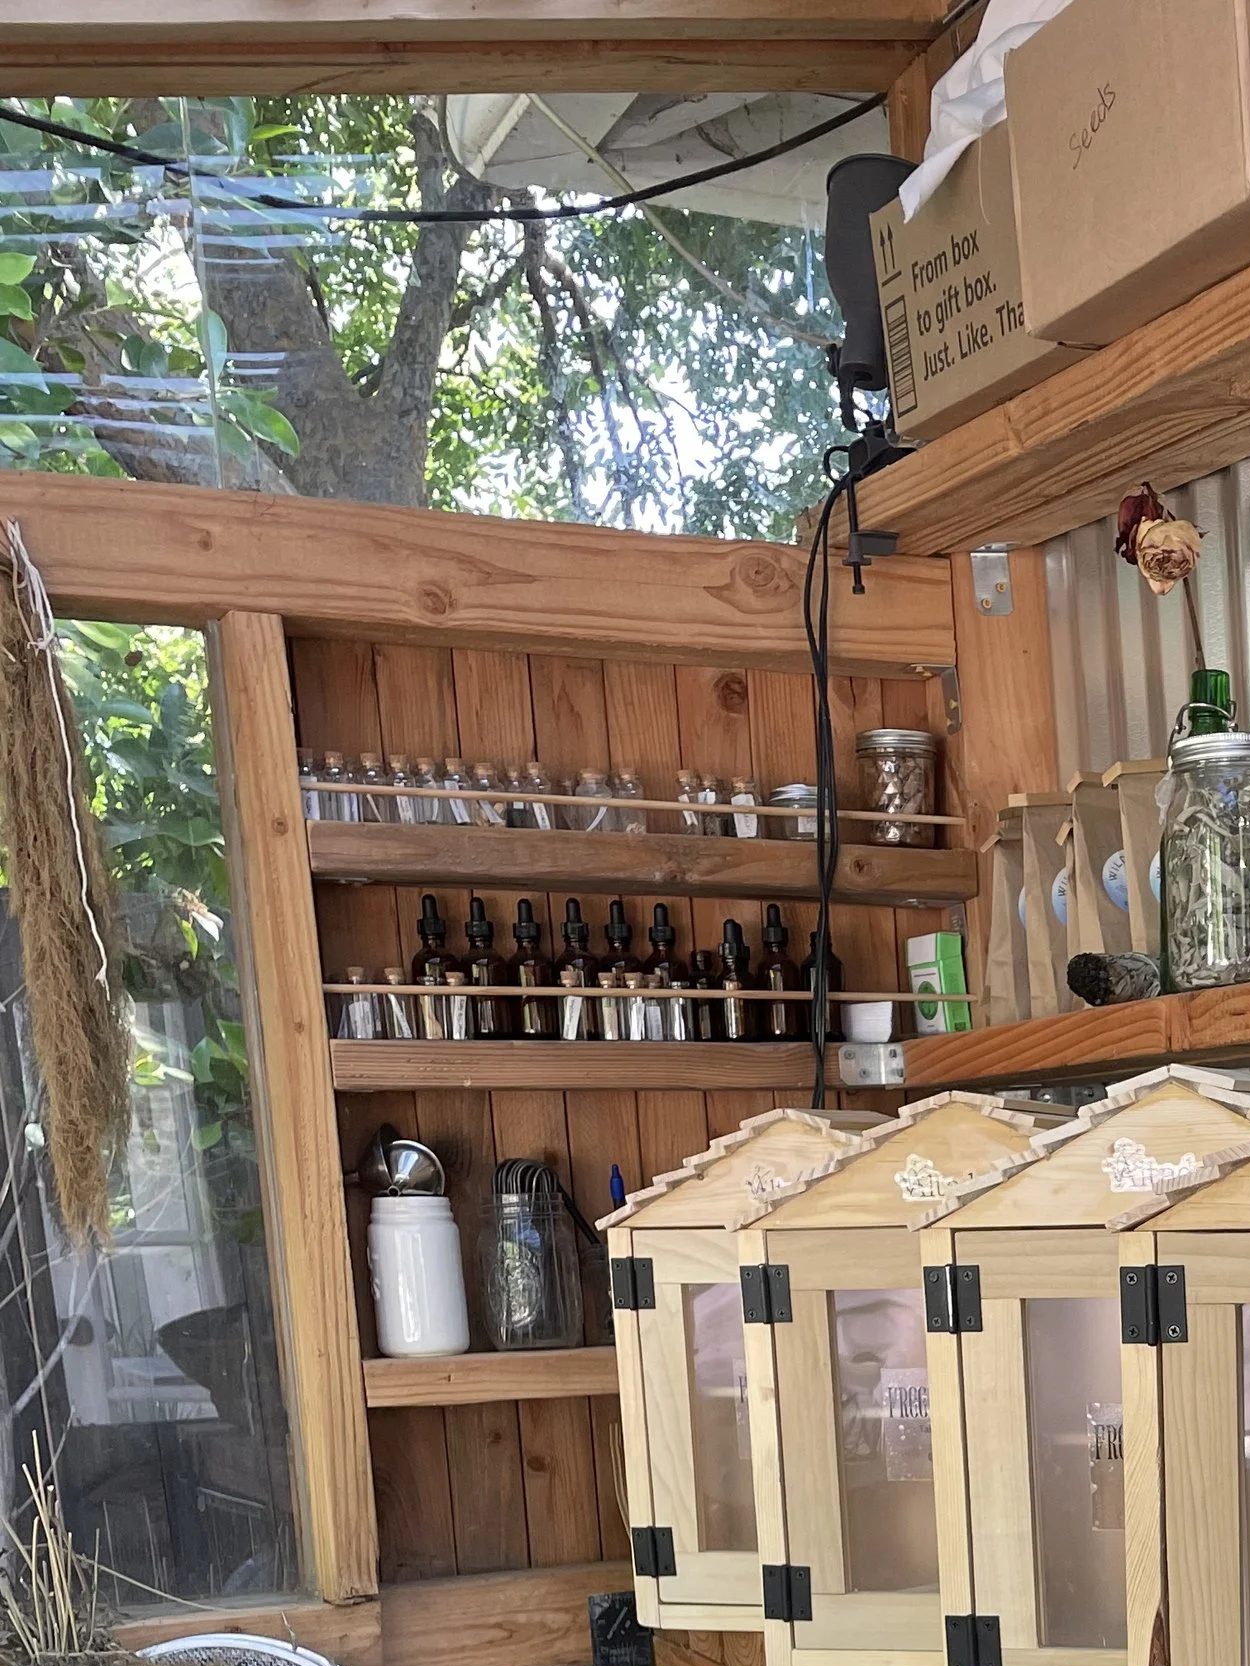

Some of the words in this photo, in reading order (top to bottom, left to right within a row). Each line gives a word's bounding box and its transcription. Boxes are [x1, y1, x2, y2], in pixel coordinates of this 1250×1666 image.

[911, 251, 949, 292] From
[951, 229, 980, 266] box
[916, 308, 932, 336] to
[934, 290, 961, 328] gift
[964, 271, 997, 308] box.
[923, 346, 956, 381] Just.
[958, 326, 994, 361] Like.
